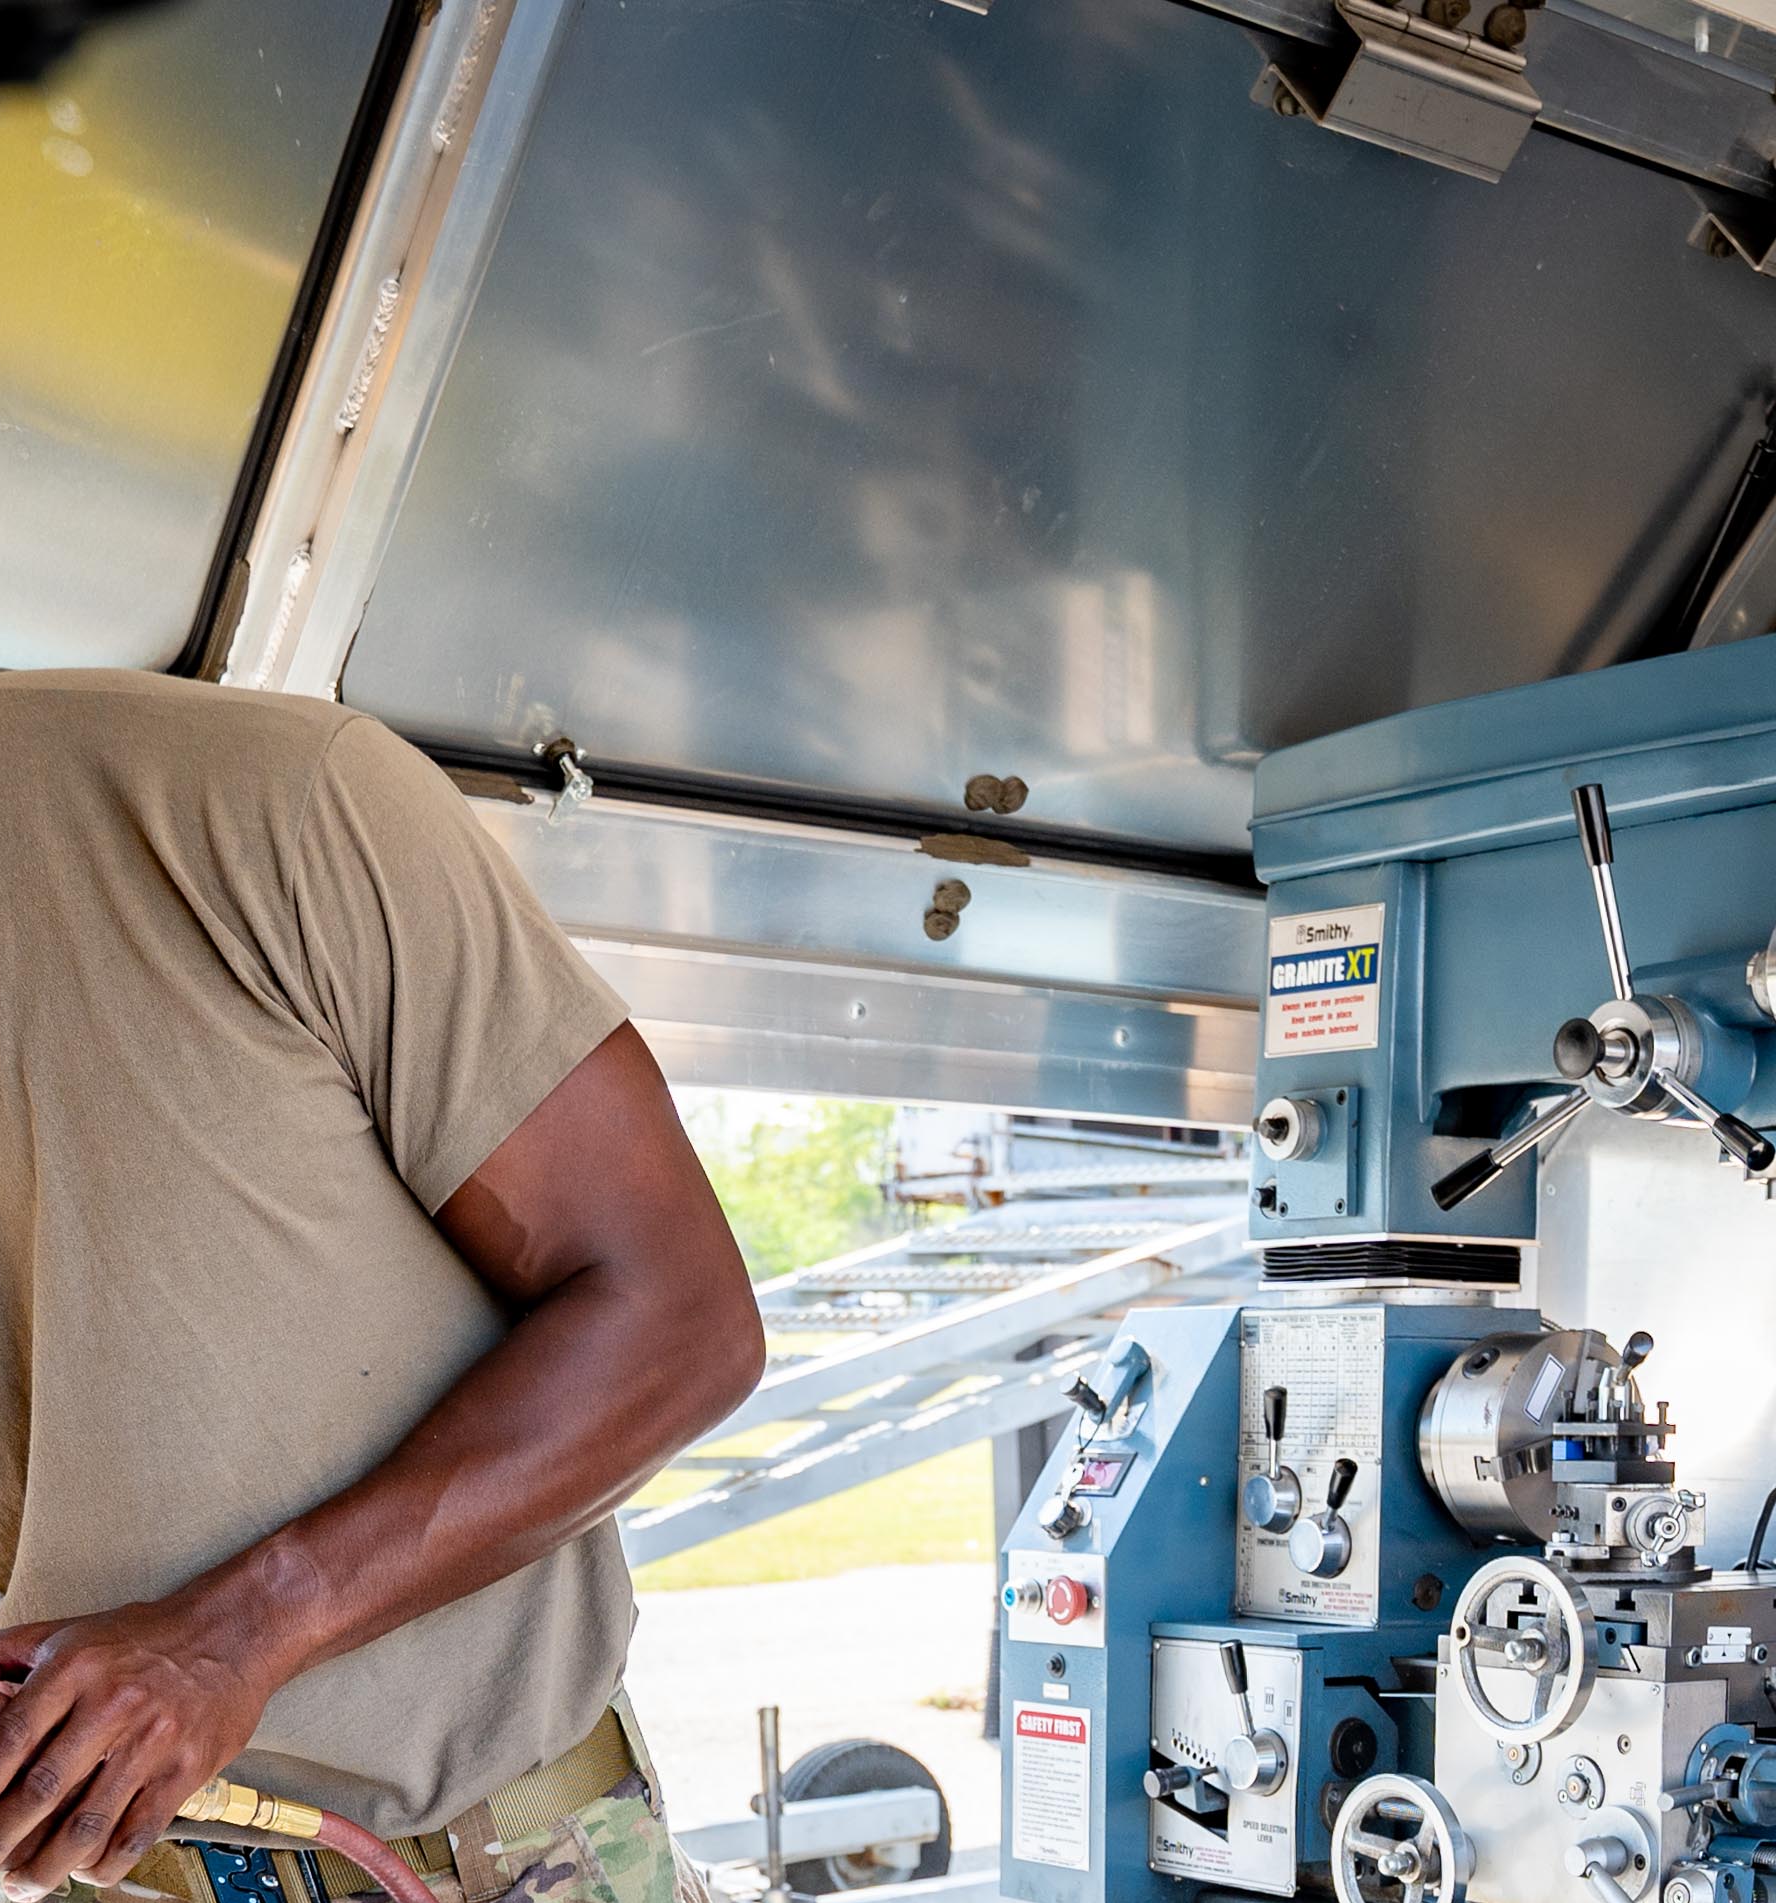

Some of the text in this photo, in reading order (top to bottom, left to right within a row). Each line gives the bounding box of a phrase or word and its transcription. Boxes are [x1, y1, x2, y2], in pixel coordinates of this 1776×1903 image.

[1306, 924, 1351, 943] Smithy
[1272, 947, 1375, 990] GRANITE XT
[1335, 994, 1364, 1005] protection
[1337, 1010, 1352, 1019] place
[1302, 1027, 1325, 1037] machine
[1329, 1024, 1358, 1035] lubricated
[1285, 1590, 1318, 1608] Smithy
[1020, 1714, 1081, 1737] SAFETY FIRST
[1243, 1820, 1288, 1835] SPEED SELECTION
[1257, 1832, 1273, 1843] LEVER
[1163, 1840, 1194, 1859] Smithy
